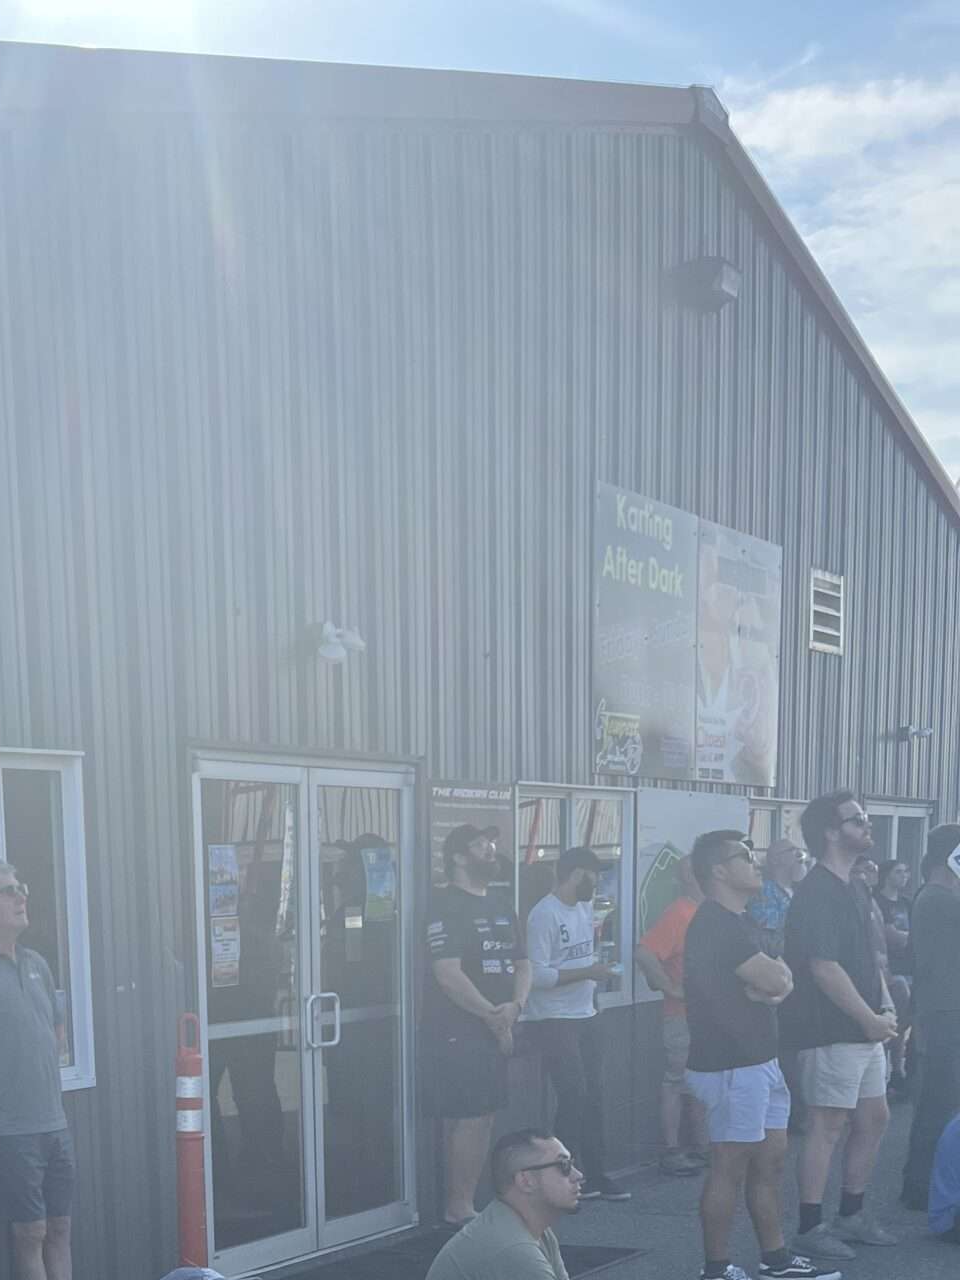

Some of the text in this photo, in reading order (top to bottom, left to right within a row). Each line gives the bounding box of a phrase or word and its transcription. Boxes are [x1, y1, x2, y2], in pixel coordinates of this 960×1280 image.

[616, 494, 672, 551] Karting
[602, 544, 683, 599] After Dark
